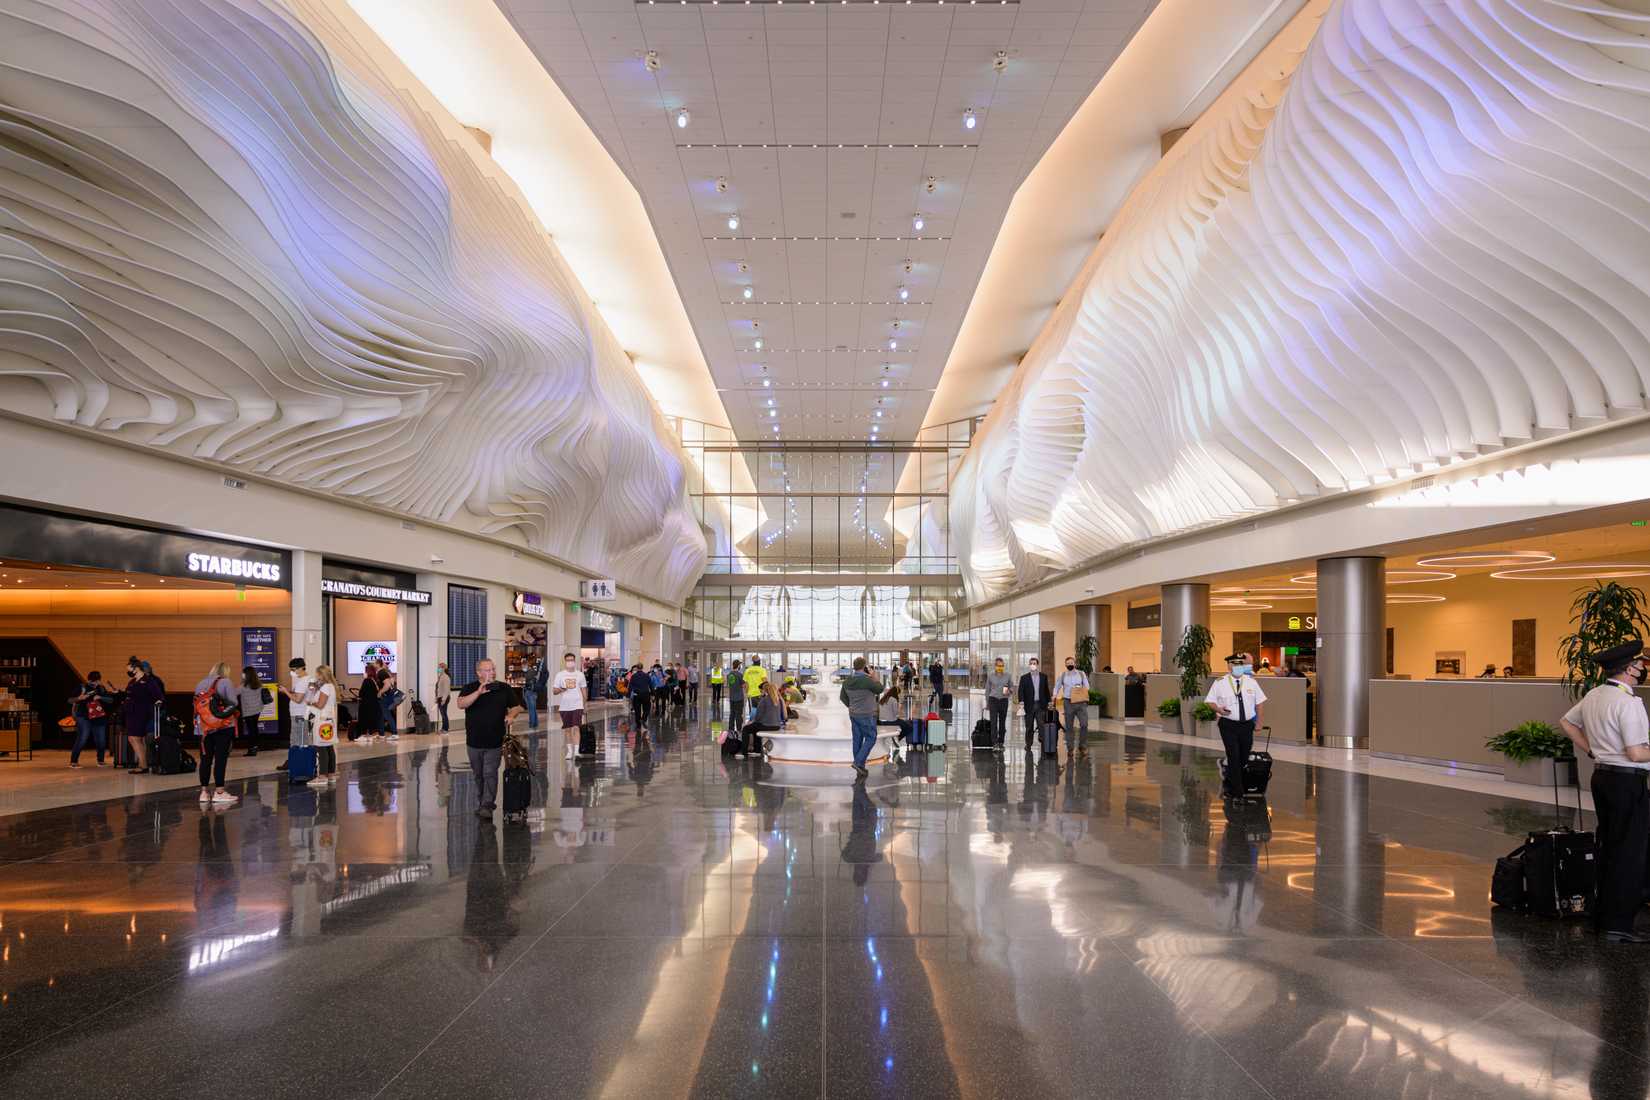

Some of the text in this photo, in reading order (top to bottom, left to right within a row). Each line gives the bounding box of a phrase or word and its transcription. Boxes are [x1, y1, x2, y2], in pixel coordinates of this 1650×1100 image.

[188, 553, 280, 581] STARBUCKS
[321, 580, 430, 603] GRANATO'S GOURMET MARKET
